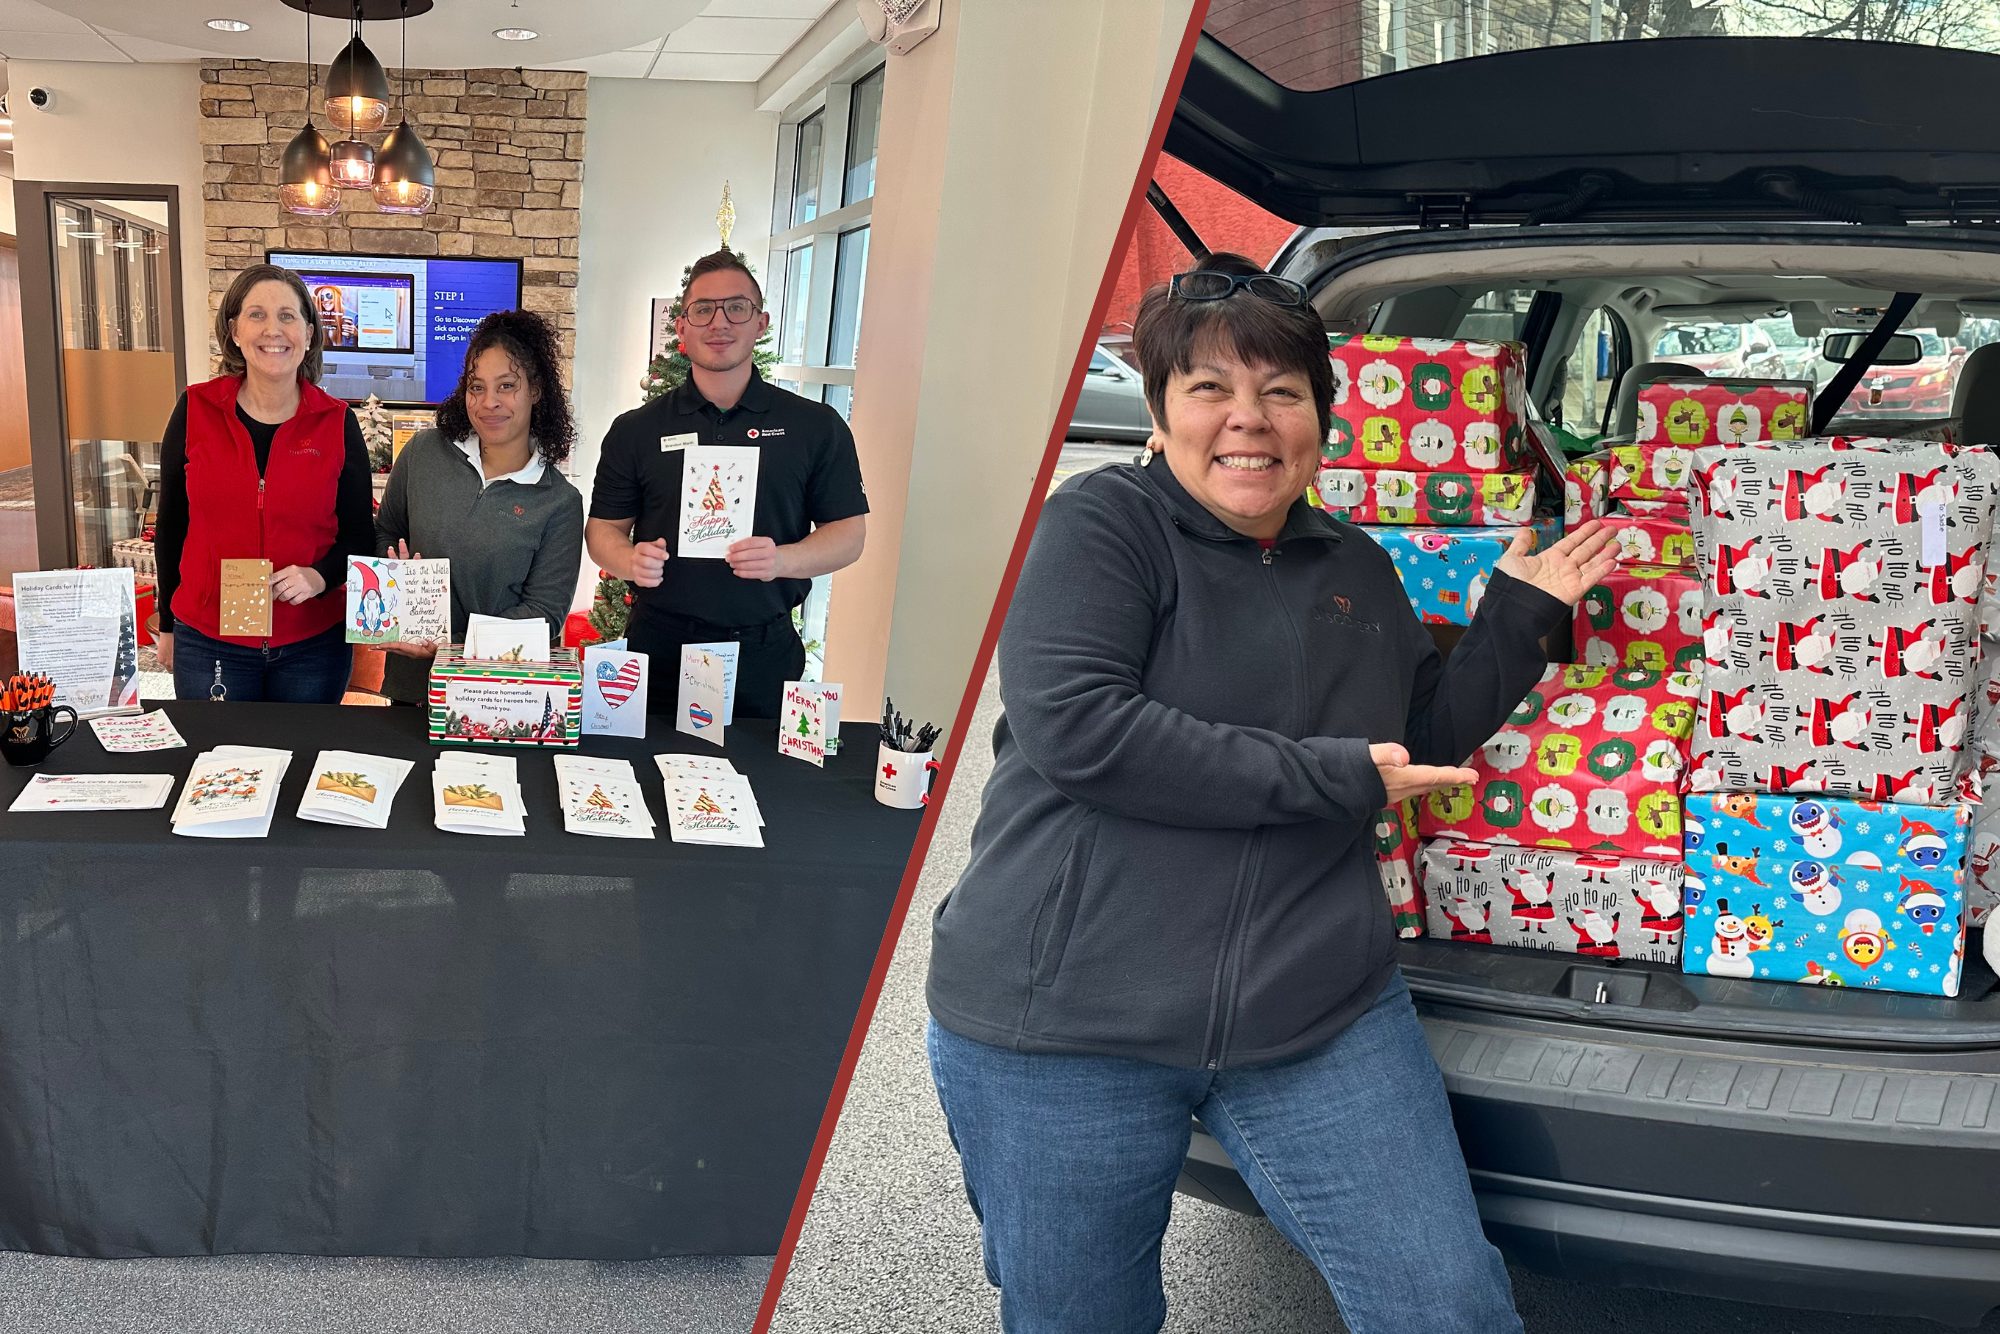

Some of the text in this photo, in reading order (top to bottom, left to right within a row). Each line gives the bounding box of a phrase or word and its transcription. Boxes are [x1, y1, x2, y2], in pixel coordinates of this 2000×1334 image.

[434, 291, 464, 301] STEP 1
[434, 324, 447, 332] click
[446, 334, 459, 342] Sign
[1732, 458, 1762, 518] HO HO HO
[1842, 462, 1873, 521] HO HO HO
[1963, 485, 1984, 501] HO
[689, 512, 729, 530] Happy
[1958, 506, 1980, 524] HO
[688, 526, 737, 542] Holidays
[1768, 535, 1798, 596] HO HO HO
[1878, 539, 1909, 600] HO HO HO
[410, 605, 437, 616] Gathered
[417, 614, 441, 624] Around
[403, 626, 424, 635] Around
[1728, 608, 1754, 668] HO HO HO
[1831, 614, 1861, 674] HO HO HO
[1941, 618, 1966, 677] HO HO HO
[686, 655, 704, 668] Merry
[788, 691, 816, 713] MERRY
[822, 690, 838, 701] YOU
[1761, 684, 1790, 742] HO HO HO
[1867, 690, 1898, 750] HO HO HO
[782, 734, 825, 758] CHRISTMAS
[1719, 751, 1748, 787] HO HO
[1822, 760, 1846, 776] HO
[1929, 766, 1951, 782] HO
[576, 806, 621, 816] Happy
[577, 814, 632, 824] Holidays
[683, 812, 730, 822] Happy
[684, 820, 740, 830] Holidays
[1500, 853, 1554, 872] HO HO HO
[1631, 864, 1684, 883] HO HO HO
[1437, 876, 1488, 900] HO HO HO
[1564, 888, 1617, 912] HO HO HO
[1522, 936, 1537, 950] HO
[1651, 948, 1666, 963] HO
